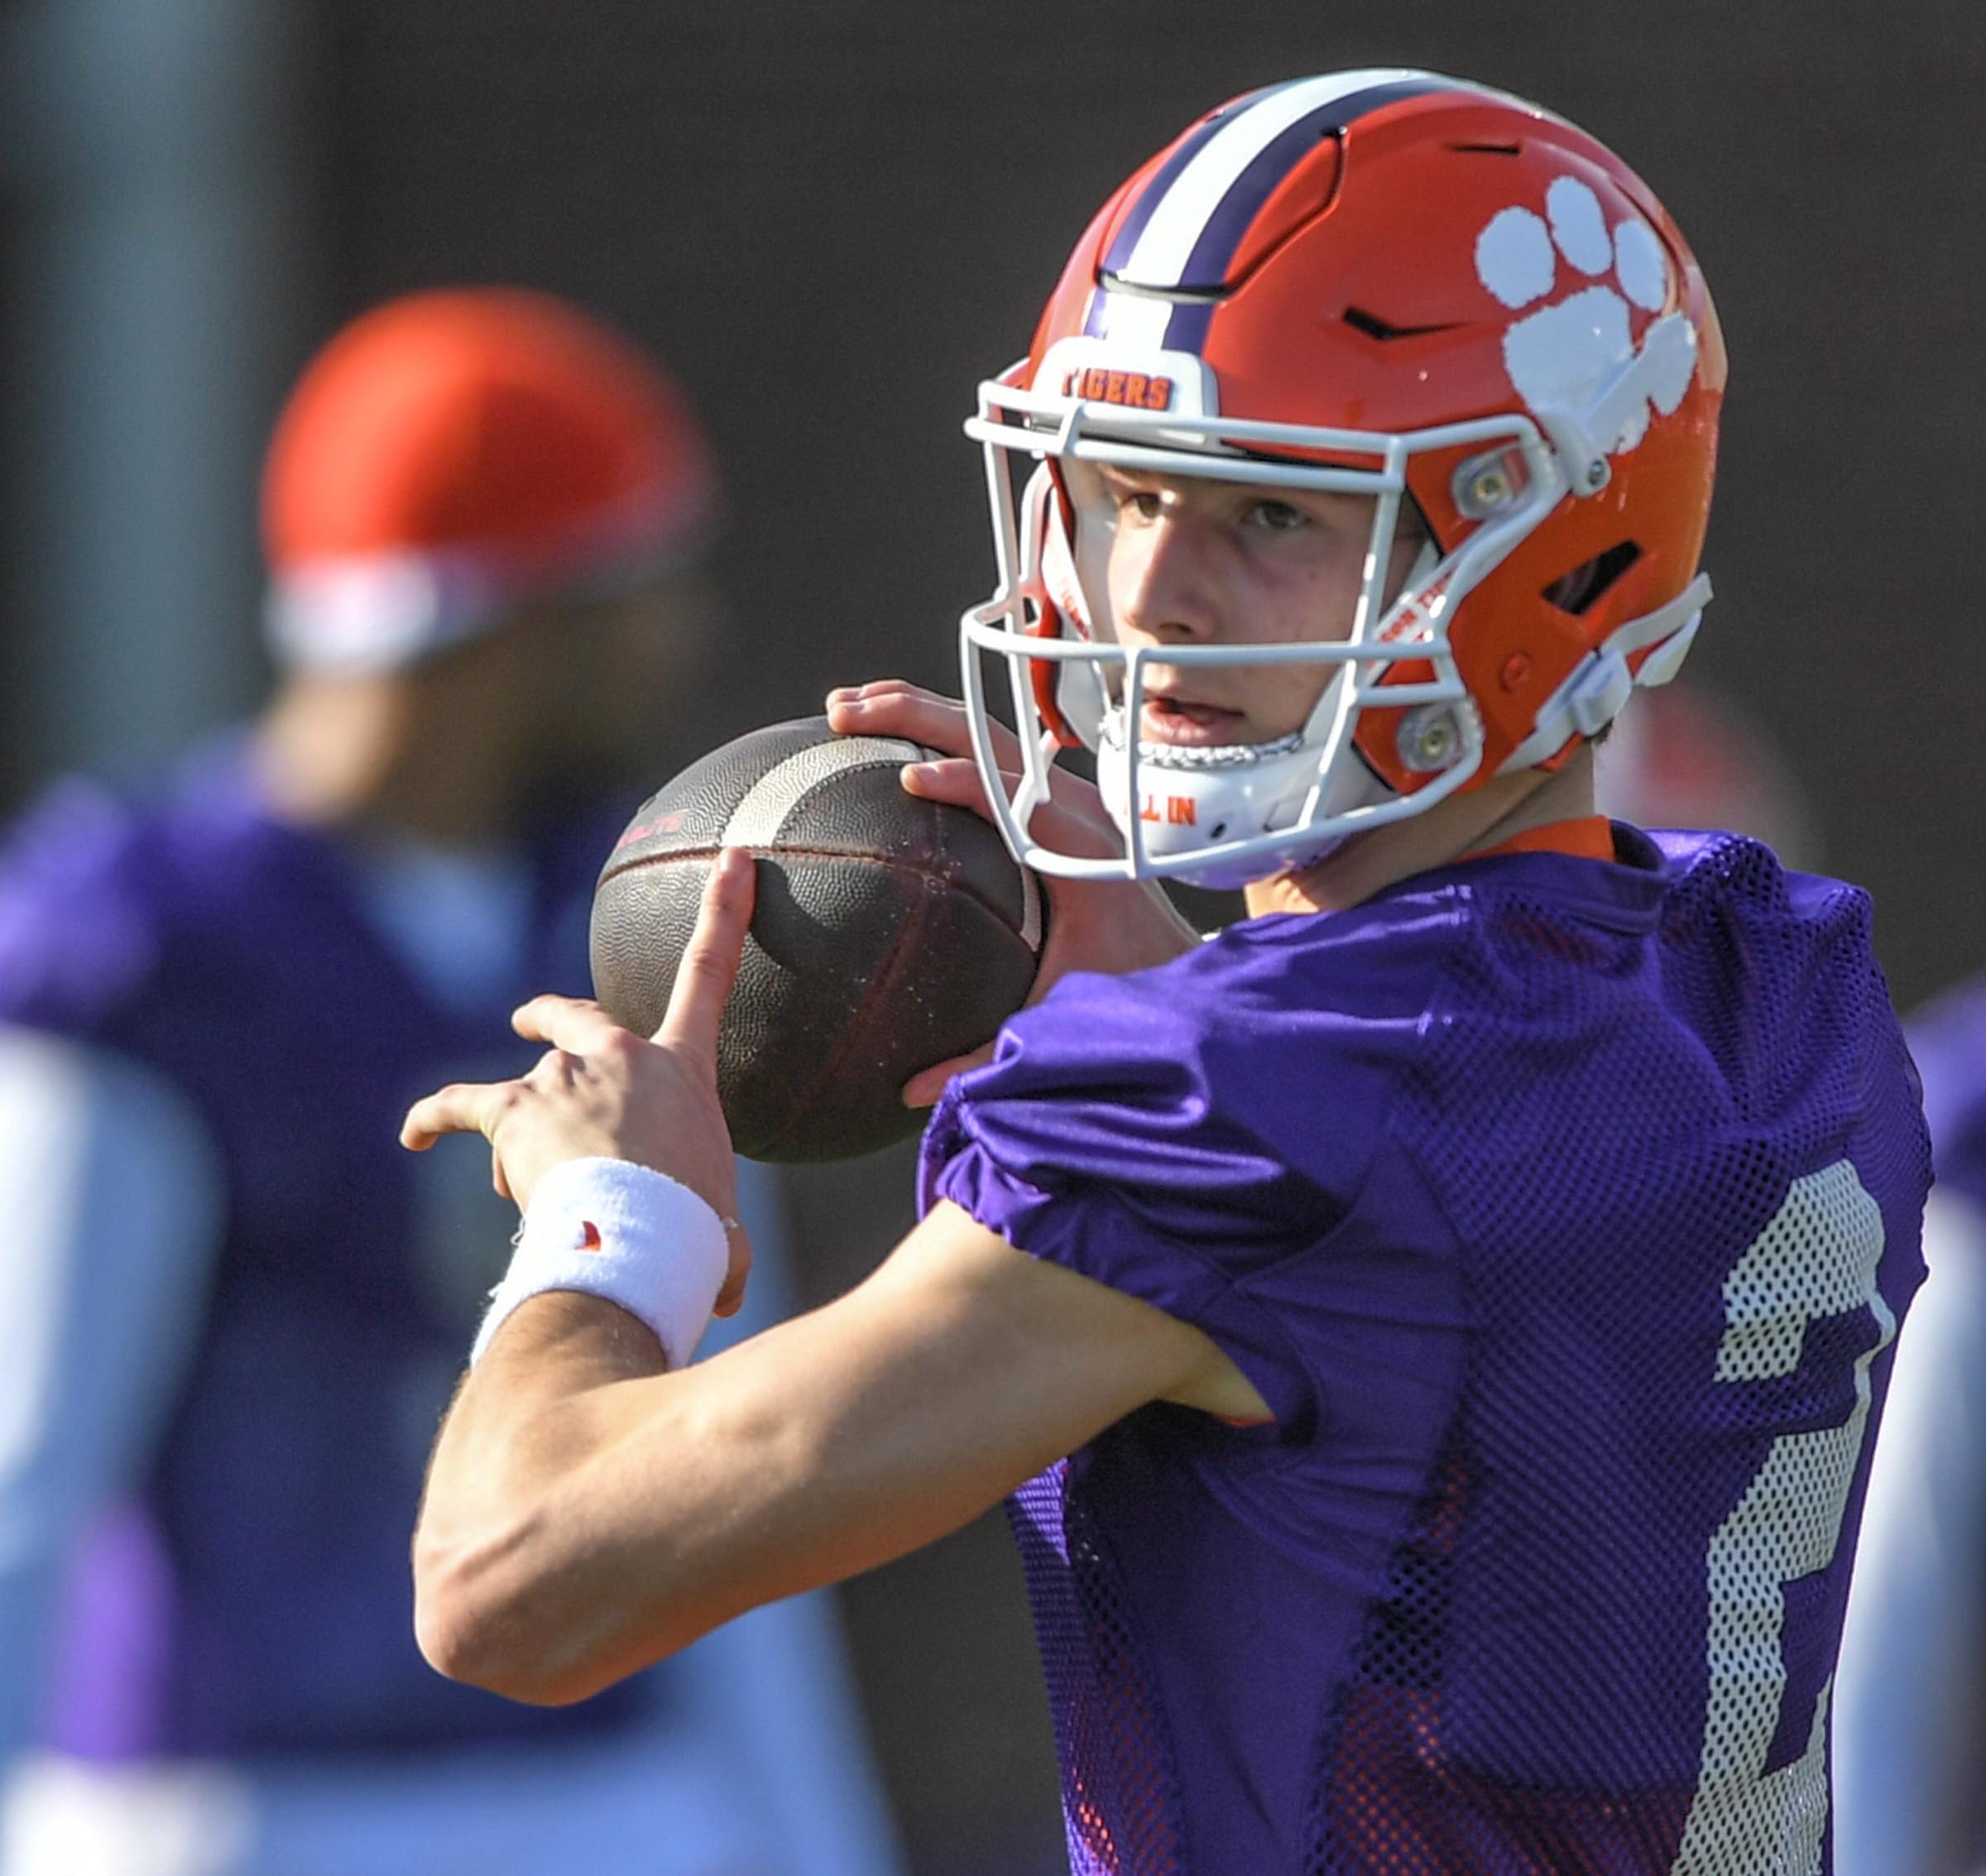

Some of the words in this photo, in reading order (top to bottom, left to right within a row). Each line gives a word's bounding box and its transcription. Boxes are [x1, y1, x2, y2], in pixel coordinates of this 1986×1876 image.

[1062, 367, 1174, 412] TIGERS
[1168, 795, 1197, 826] IN
[1670, 1158, 1897, 1876] 2
